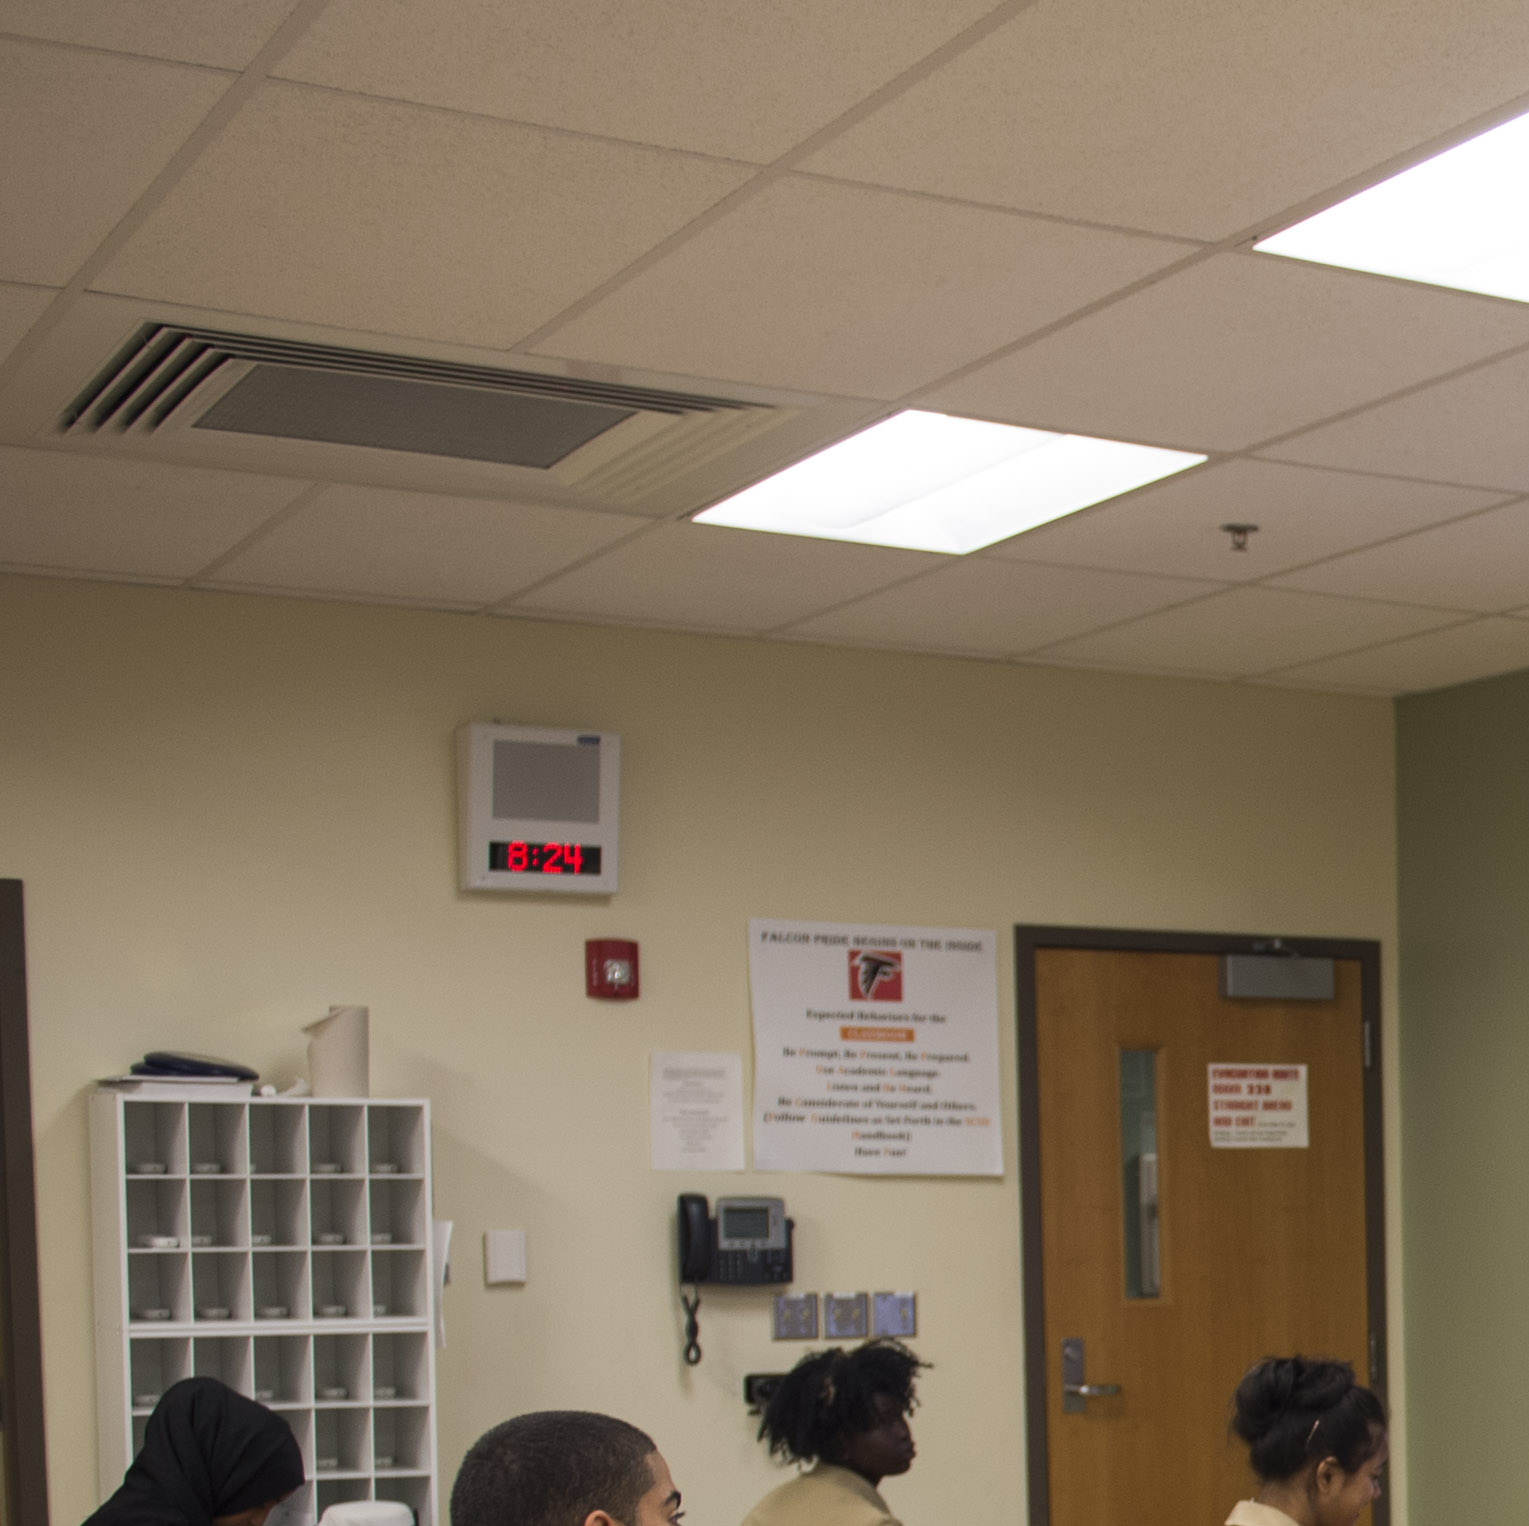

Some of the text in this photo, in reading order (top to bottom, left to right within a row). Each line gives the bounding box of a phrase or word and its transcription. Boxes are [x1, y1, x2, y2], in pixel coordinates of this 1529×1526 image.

[507, 840, 585, 875] 8:24
[813, 934, 849, 947] PRIDE
[919, 939, 942, 951] THE
